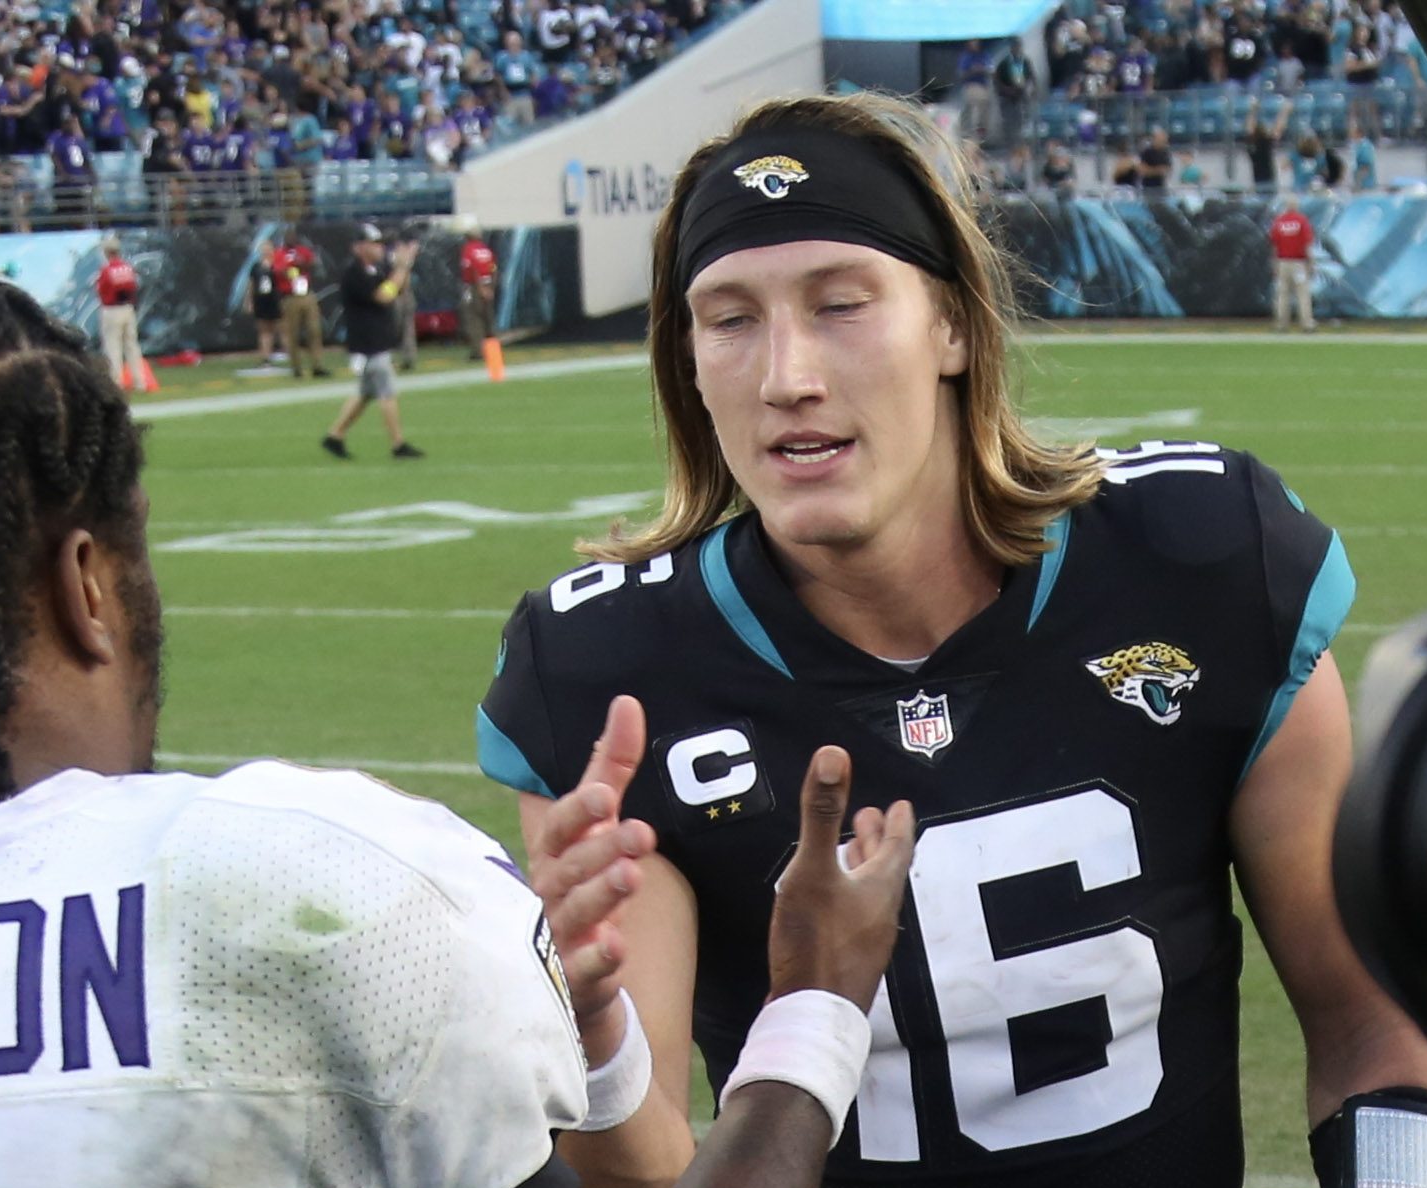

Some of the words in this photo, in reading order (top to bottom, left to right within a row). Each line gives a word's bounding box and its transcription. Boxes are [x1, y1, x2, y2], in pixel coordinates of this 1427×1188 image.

[585, 165, 642, 215] TIAA
[644, 163, 672, 212] Ba
[908, 718, 945, 745] NFL
[664, 727, 758, 807] C
